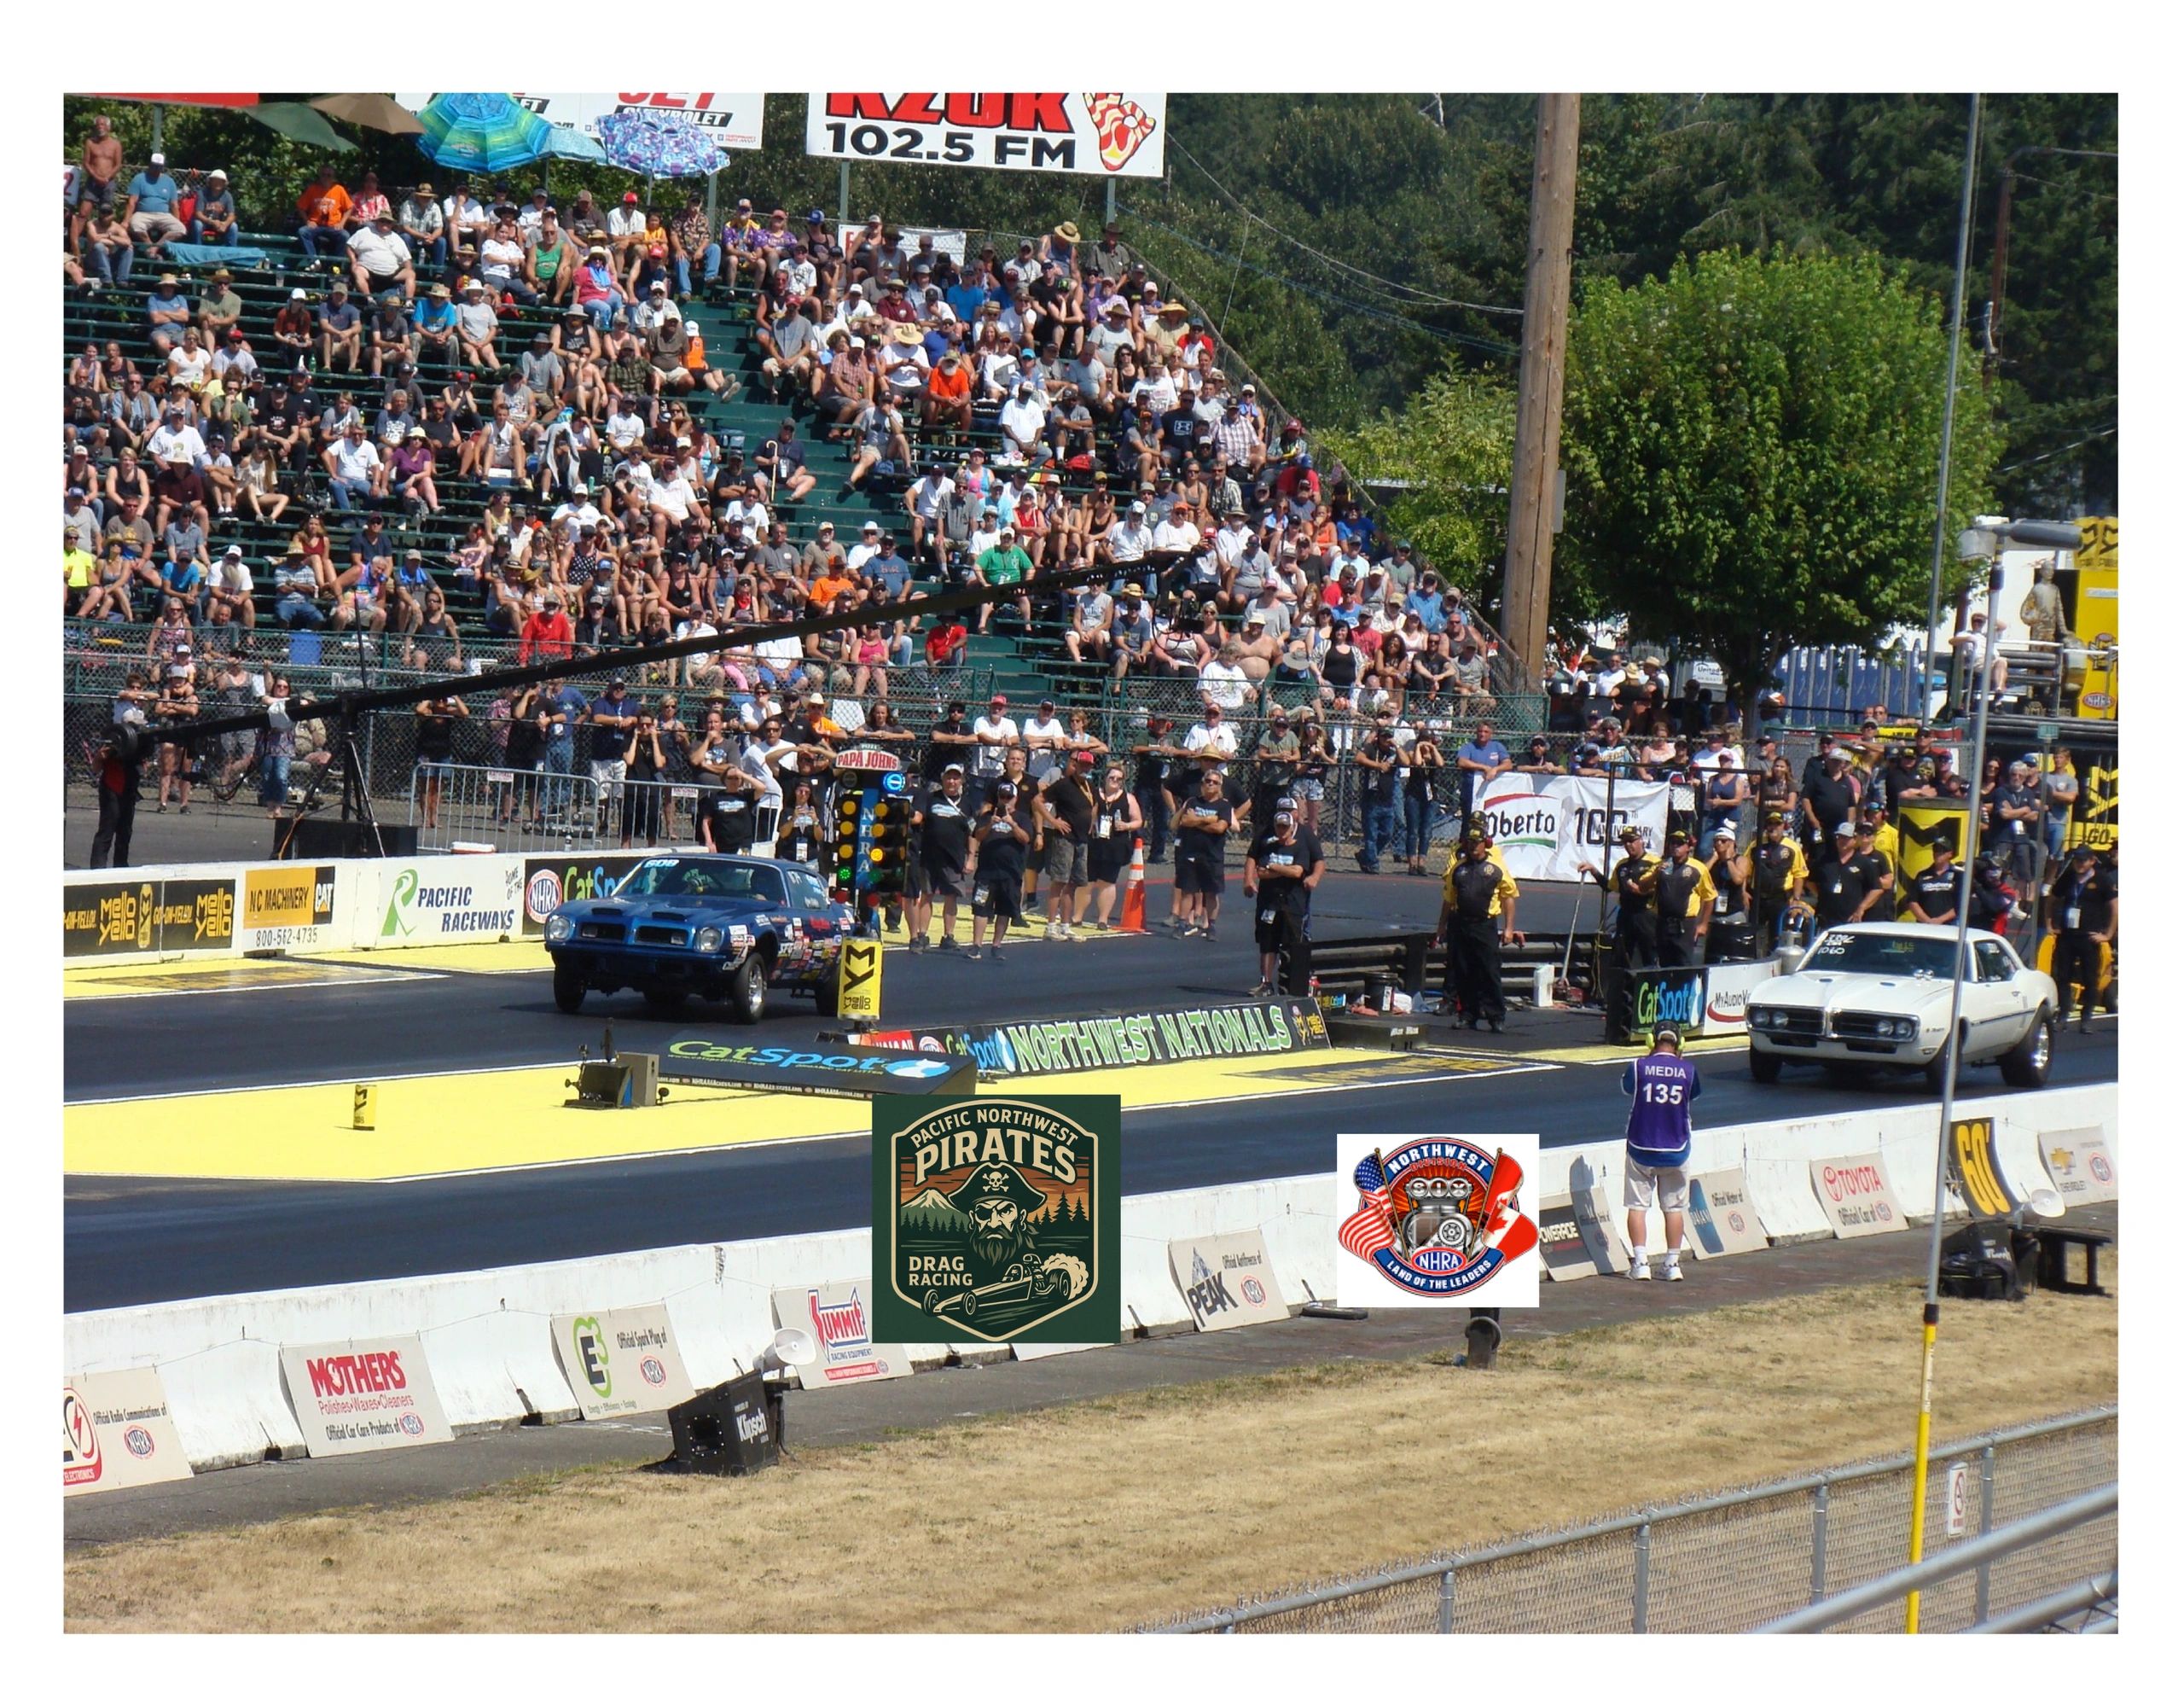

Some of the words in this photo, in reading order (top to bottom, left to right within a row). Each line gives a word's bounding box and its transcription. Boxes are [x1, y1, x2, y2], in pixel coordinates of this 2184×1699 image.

[826, 122, 974, 162] 102.5
[994, 134, 1075, 169] FM
[837, 753, 865, 767] PAPA
[865, 751, 898, 770] JOHNS
[249, 889, 263, 912] NC
[264, 887, 310, 911] MACHINERY
[315, 883, 334, 912] CAT
[417, 887, 473, 908] PACIFIC
[531, 879, 557, 914] NHRA
[441, 909, 514, 932] RACEWAYS
[1638, 981, 1690, 1024] CatSpot
[1007, 1014, 1163, 1073] NORTHWEST
[1156, 1005, 1293, 1058] NATIONALS
[669, 1040, 886, 1070] CatSpot
[1645, 1065, 1687, 1079] MEDIA
[1642, 1083, 1683, 1105] 135
[1838, 1166, 1884, 1196] TOYOTA
[1838, 1205, 1861, 1226] Official
[1186, 1271, 1239, 1328] PEAK
[809, 1293, 865, 1350] SUMMIT
[617, 1330, 634, 1349] Official
[634, 1329, 649, 1352] Spark
[648, 1327, 664, 1349] Plug
[306, 1351, 406, 1397] MOTHERS
[93, 1411, 111, 1425] Official
[110, 1409, 125, 1423] Radio
[124, 1405, 160, 1422] Communications
[326, 1423, 347, 1440] Official
[346, 1423, 357, 1439] Car
[356, 1422, 370, 1437] Care
[370, 1419, 394, 1435] Products
[393, 1417, 401, 1433] of
[736, 1407, 767, 1444] Klipsch
